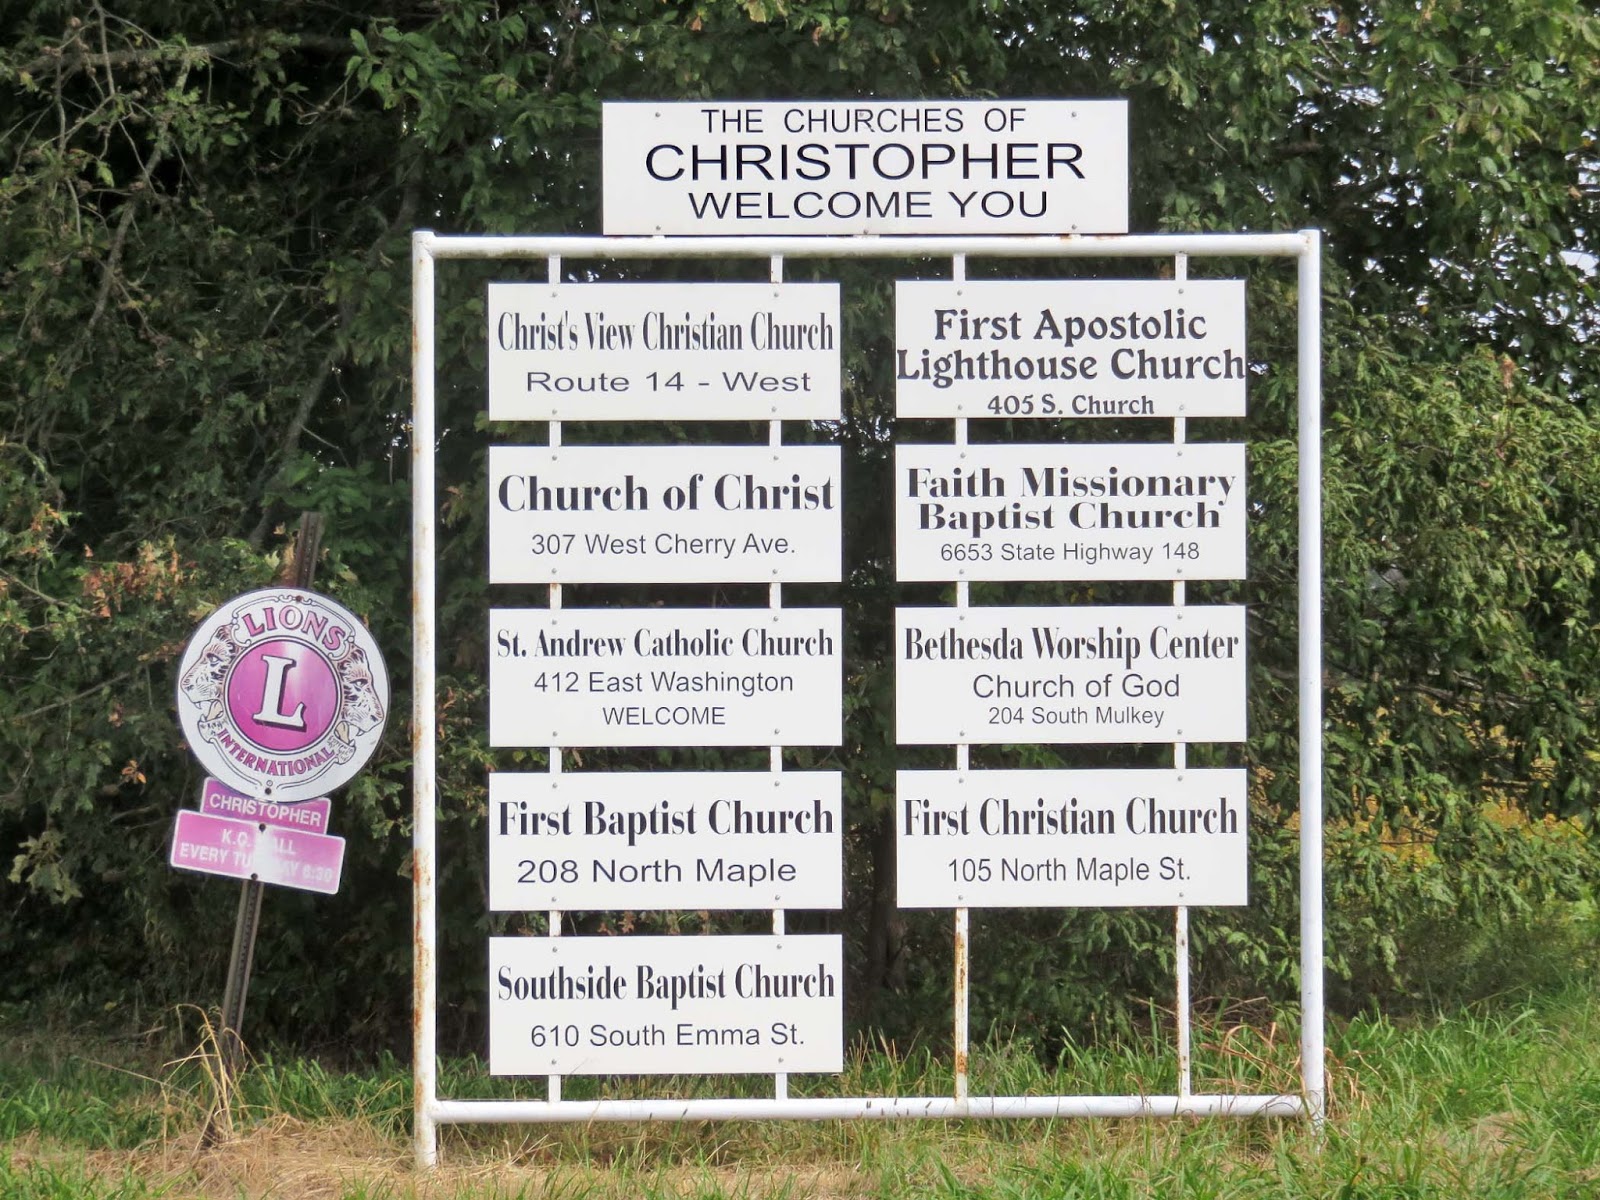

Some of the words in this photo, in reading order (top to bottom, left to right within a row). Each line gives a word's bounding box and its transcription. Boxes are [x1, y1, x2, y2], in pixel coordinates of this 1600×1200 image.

[701, 108, 763, 134] THE
[785, 108, 963, 133] CHURCHES
[984, 107, 1026, 133] OF
[645, 142, 1086, 182] CHRISTOPHER
[688, 191, 933, 220] WELCOME
[948, 190, 1047, 218] YOU
[498, 310, 578, 350] Christ's
[584, 312, 633, 351] View
[642, 311, 742, 351] Christian
[750, 312, 833, 351] Church
[934, 308, 1022, 341] First
[1033, 308, 1207, 348] Apostolic
[527, 371, 630, 392] Route
[646, 371, 685, 392] 14
[722, 371, 811, 392] West
[897, 348, 1098, 389] Lighthouse
[1111, 348, 1245, 380] Church
[987, 395, 1034, 415] 405
[1042, 394, 1063, 415] S.
[1072, 394, 1155, 415] Church
[498, 475, 648, 512] Church
[663, 473, 704, 511] of
[714, 473, 833, 511] Christ
[907, 467, 1005, 498] Faith
[1021, 466, 1236, 506] Missionary
[918, 502, 1055, 538] Baptist
[1069, 501, 1222, 529] Church
[532, 534, 576, 555] 307
[584, 534, 647, 555] West
[655, 533, 736, 559] Cherry
[742, 533, 795, 554] Ave.
[941, 543, 993, 561] 6653
[1001, 543, 1055, 561] State
[1063, 542, 1153, 565] Highway
[1163, 542, 1200, 560] 148
[243, 605, 346, 649] LIONS
[497, 630, 527, 657] St.
[535, 629, 623, 657] Andrew
[634, 628, 733, 657] Catholic
[742, 628, 833, 656] Church
[905, 627, 1023, 660] Bethesda
[1031, 626, 1141, 670] Worship
[1150, 625, 1239, 660] Center
[253, 654, 306, 732] L
[534, 671, 579, 692] 412
[589, 671, 643, 693] East
[650, 671, 793, 697] Washington
[973, 674, 1074, 699] Church
[1085, 673, 1113, 698] of
[1122, 673, 1179, 698] God
[602, 706, 726, 725] WELCOME
[989, 706, 1024, 724] 204
[1032, 706, 1088, 724] South
[1096, 706, 1164, 728] Mulkey
[217, 728, 335, 777] INTERNATIONAL
[209, 793, 322, 828] CHRISTOPHER
[500, 801, 571, 836] First
[584, 800, 696, 847] Baptist
[708, 799, 833, 835] Church
[904, 798, 969, 836] First
[979, 797, 1115, 836] Christian
[1126, 797, 1238, 835] Church
[180, 842, 229, 865] EVERY
[517, 859, 579, 884] 208
[593, 859, 682, 883] North
[696, 858, 796, 888] Maple
[948, 858, 992, 882] 105
[1001, 858, 1066, 882] North
[1077, 857, 1150, 887] Maple
[1159, 856, 1191, 881] St.
[498, 965, 627, 1000] Southside
[637, 964, 726, 1010] Baptist
[735, 963, 834, 998] Church
[531, 1024, 579, 1048] 610
[589, 1024, 665, 1047] South
[677, 1023, 760, 1046] Emma
[771, 1022, 804, 1045] St.
